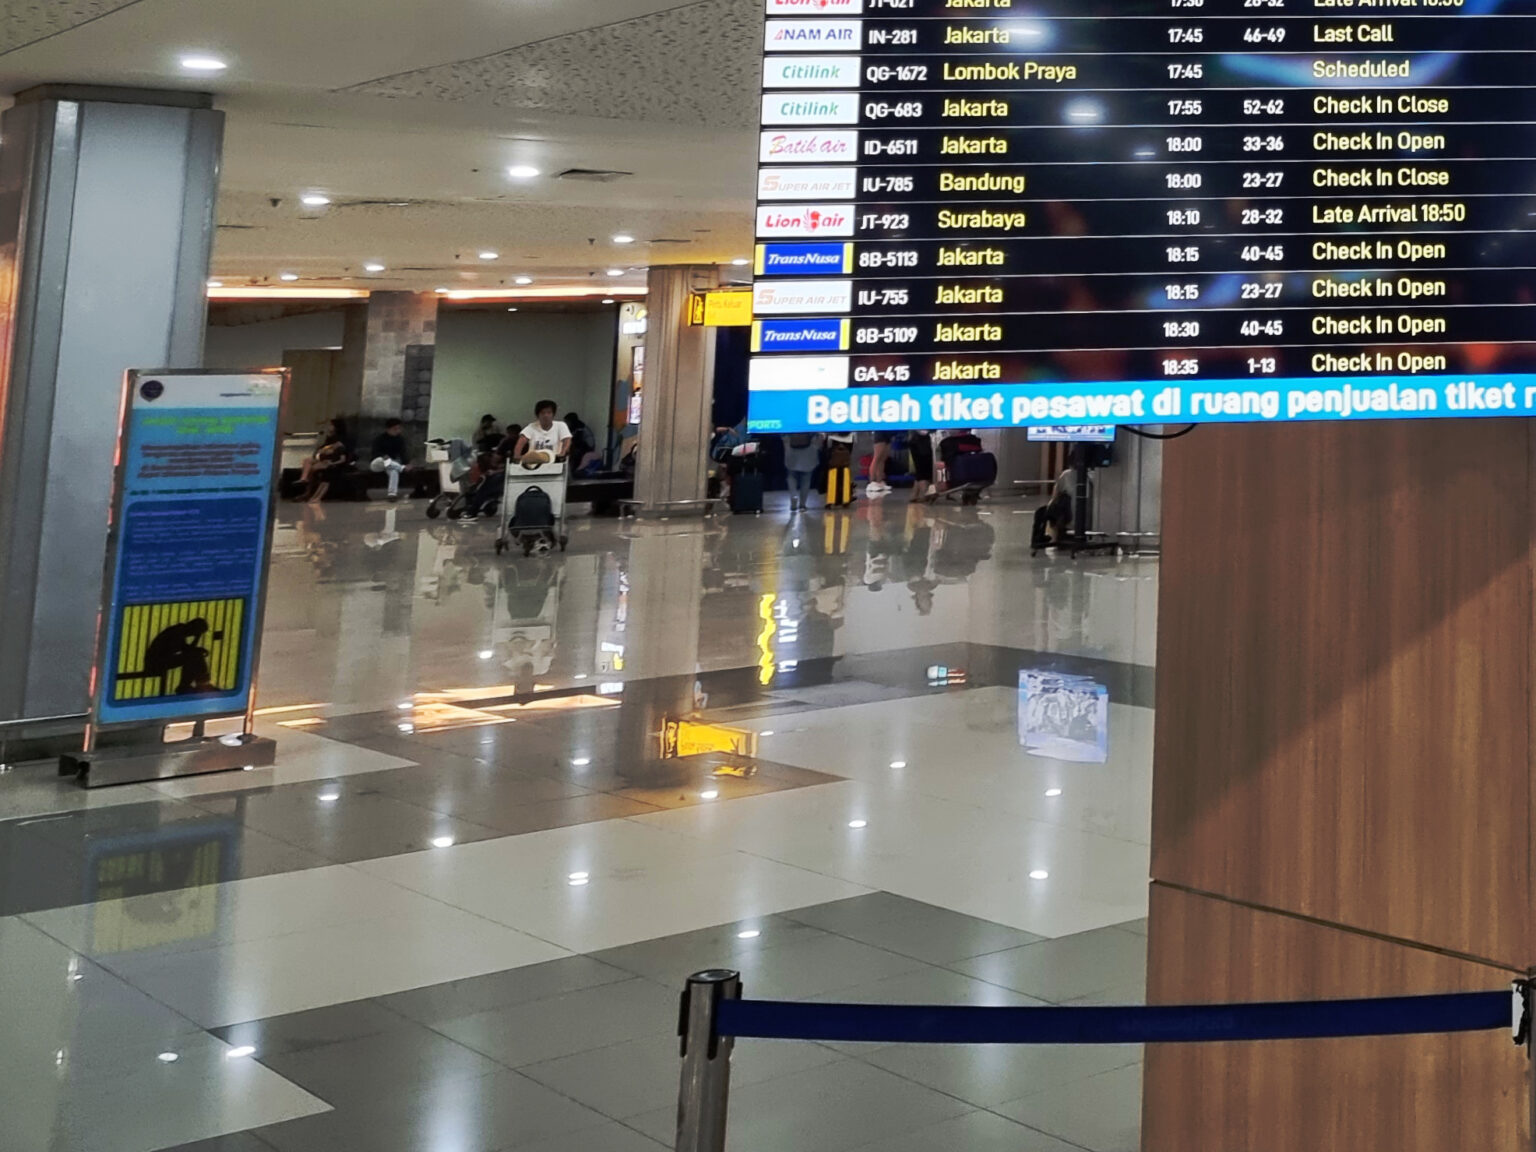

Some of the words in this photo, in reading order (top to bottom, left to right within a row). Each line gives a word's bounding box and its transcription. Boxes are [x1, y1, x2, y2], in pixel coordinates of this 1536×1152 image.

[825, 28, 853, 40] AIR
[869, 30, 917, 44] IN-281
[944, 26, 1009, 45] Jakarta
[1168, 29, 1203, 42] 17:45
[1244, 28, 1285, 42] 46-49
[1314, 25, 1353, 42] Last
[1358, 25, 1393, 41] Call
[780, 101, 839, 116] Citilink
[865, 103, 922, 119] QG-683
[942, 99, 1008, 116] Jakarta
[1168, 100, 1202, 115] 17:55
[1244, 100, 1283, 114] 52-62
[1314, 96, 1372, 113] Check
[1377, 96, 1392, 113] In
[1398, 96, 1448, 113] Close
[765, 214, 801, 228] Lion
[821, 213, 845, 227] air
[860, 214, 909, 229] JT-923
[938, 210, 1025, 230] Surabaya
[1167, 209, 1200, 225] 18:10
[1242, 209, 1283, 224] 28-32
[1313, 206, 1353, 223] Late
[1358, 205, 1418, 222] Arrival
[1421, 204, 1465, 221] 18:50
[767, 253, 840, 265] TransNusa
[859, 251, 918, 267] 8B-5113
[937, 248, 1004, 265] Jakarta
[1166, 247, 1199, 262] 18:15
[1241, 246, 1283, 261] 40-45
[1313, 242, 1372, 260] Check
[1377, 241, 1392, 259] In
[1398, 241, 1445, 261] Open
[807, 394, 921, 425] Belilah
[929, 392, 1004, 421] tiket
[1012, 389, 1145, 425] pesawat
[1152, 387, 1181, 416] di
[1190, 391, 1280, 419] ruang
[1287, 383, 1437, 418] penjualan
[1445, 381, 1516, 410] tiket
